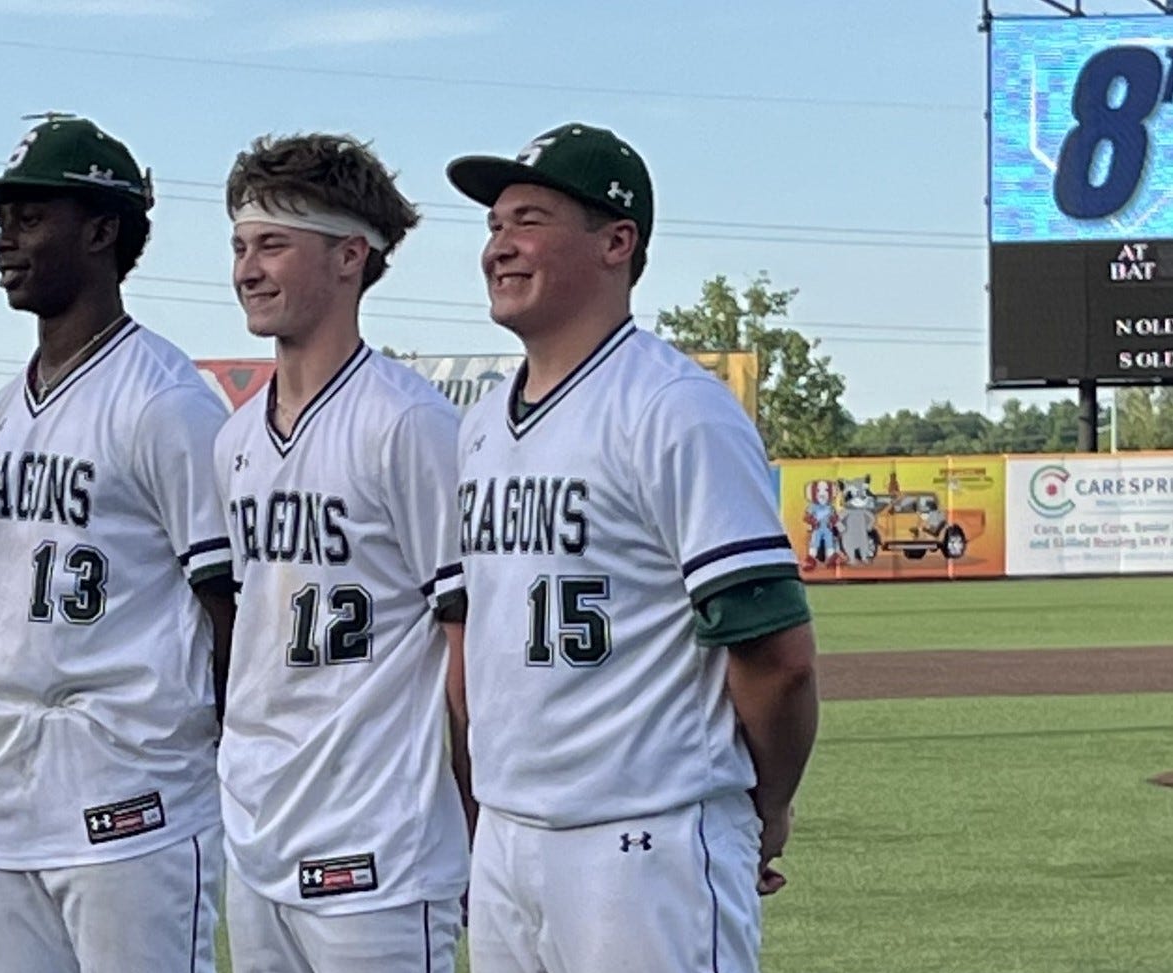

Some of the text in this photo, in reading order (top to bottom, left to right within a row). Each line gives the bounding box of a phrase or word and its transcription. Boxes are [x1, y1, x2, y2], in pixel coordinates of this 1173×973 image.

[1109, 261, 1157, 281] BAT
[1117, 243, 1149, 261] AT
[27, 539, 110, 626] 13
[285, 582, 374, 667] 12
[525, 574, 612, 668] 15
